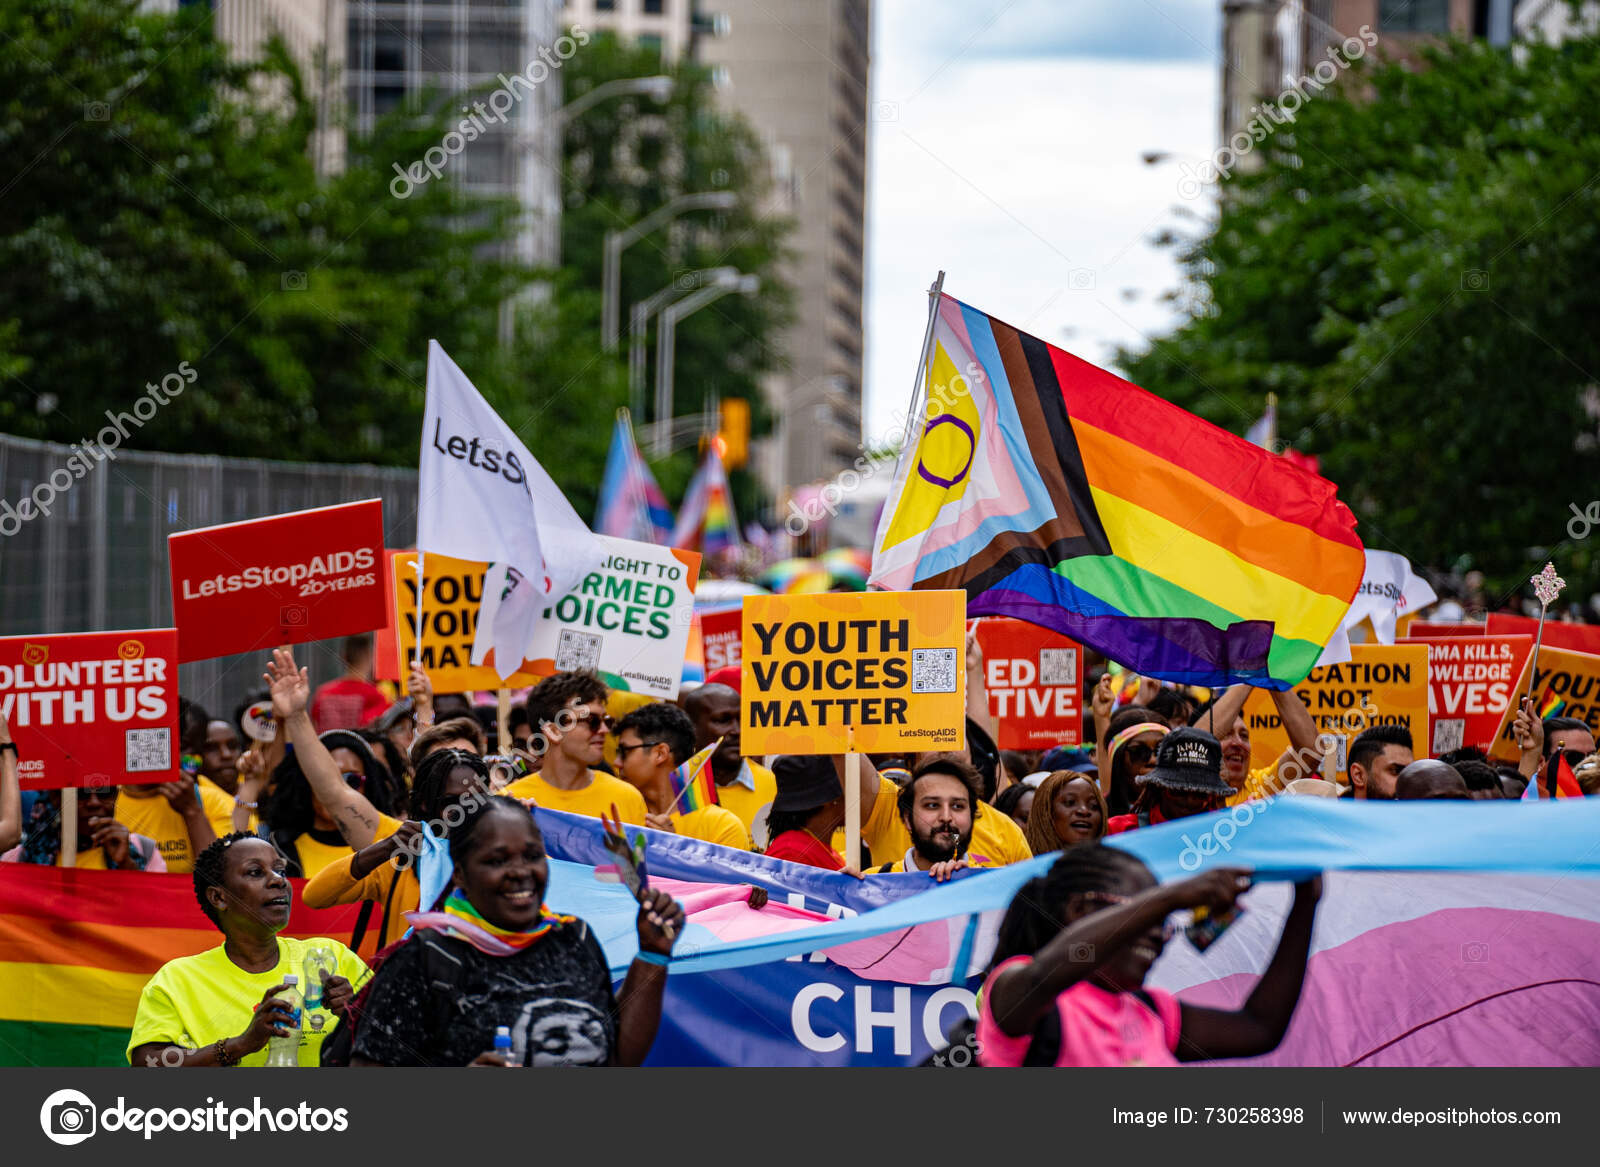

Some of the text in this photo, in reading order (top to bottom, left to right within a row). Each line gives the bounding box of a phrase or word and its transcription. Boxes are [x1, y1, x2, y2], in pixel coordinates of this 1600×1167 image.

[434, 416, 530, 488] LetsS
[183, 547, 374, 600] LetsStopAIDS
[601, 555, 681, 581] IGHT TO
[571, 572, 676, 609] RMED
[542, 594, 671, 640] OICES
[752, 619, 909, 655] YOUTH
[1464, 644, 1514, 661] KILLS,
[752, 658, 908, 691] VOICES
[988, 658, 1036, 687] ED
[1307, 663, 1411, 684] CATION
[105, 685, 168, 722] US
[750, 698, 908, 728] MATTER
[985, 687, 1077, 717] TIVE
[1319, 689, 1373, 709] NOT
[899, 728, 957, 738] LetsStopAIDS
[1250, 714, 1411, 729] INDTRINATION
[791, 982, 979, 1056] CHO
